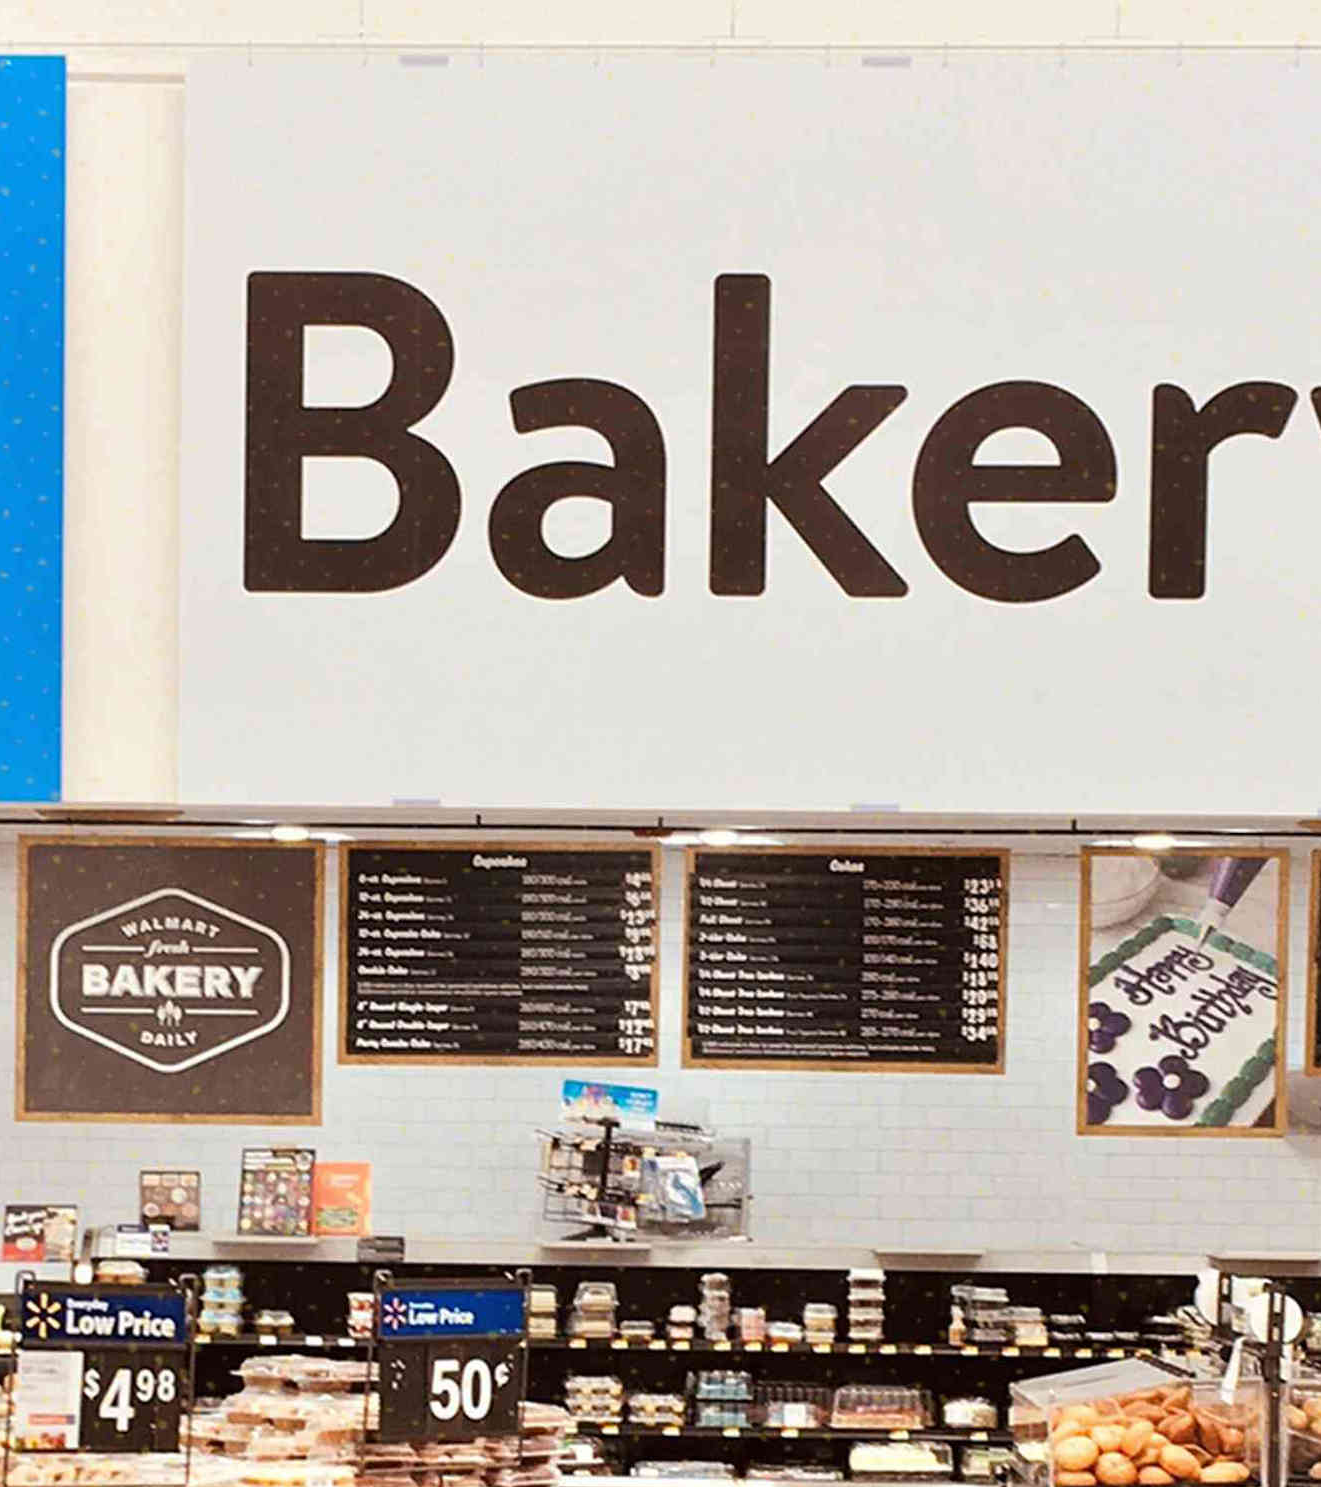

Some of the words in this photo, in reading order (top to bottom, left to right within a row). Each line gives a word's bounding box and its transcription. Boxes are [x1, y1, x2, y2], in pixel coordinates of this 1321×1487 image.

[121, 917, 221, 939] WALMART
[144, 939, 191, 959] fresh
[81, 963, 263, 999] BAKERY
[1114, 944, 1215, 1006] Happy
[1149, 965, 1278, 1060] Birthday
[140, 1030, 199, 1047] DAILY
[65, 1312, 116, 1336] Low
[117, 1310, 176, 1338] Price
[408, 1309, 438, 1326] Low
[439, 1307, 475, 1326] Price
